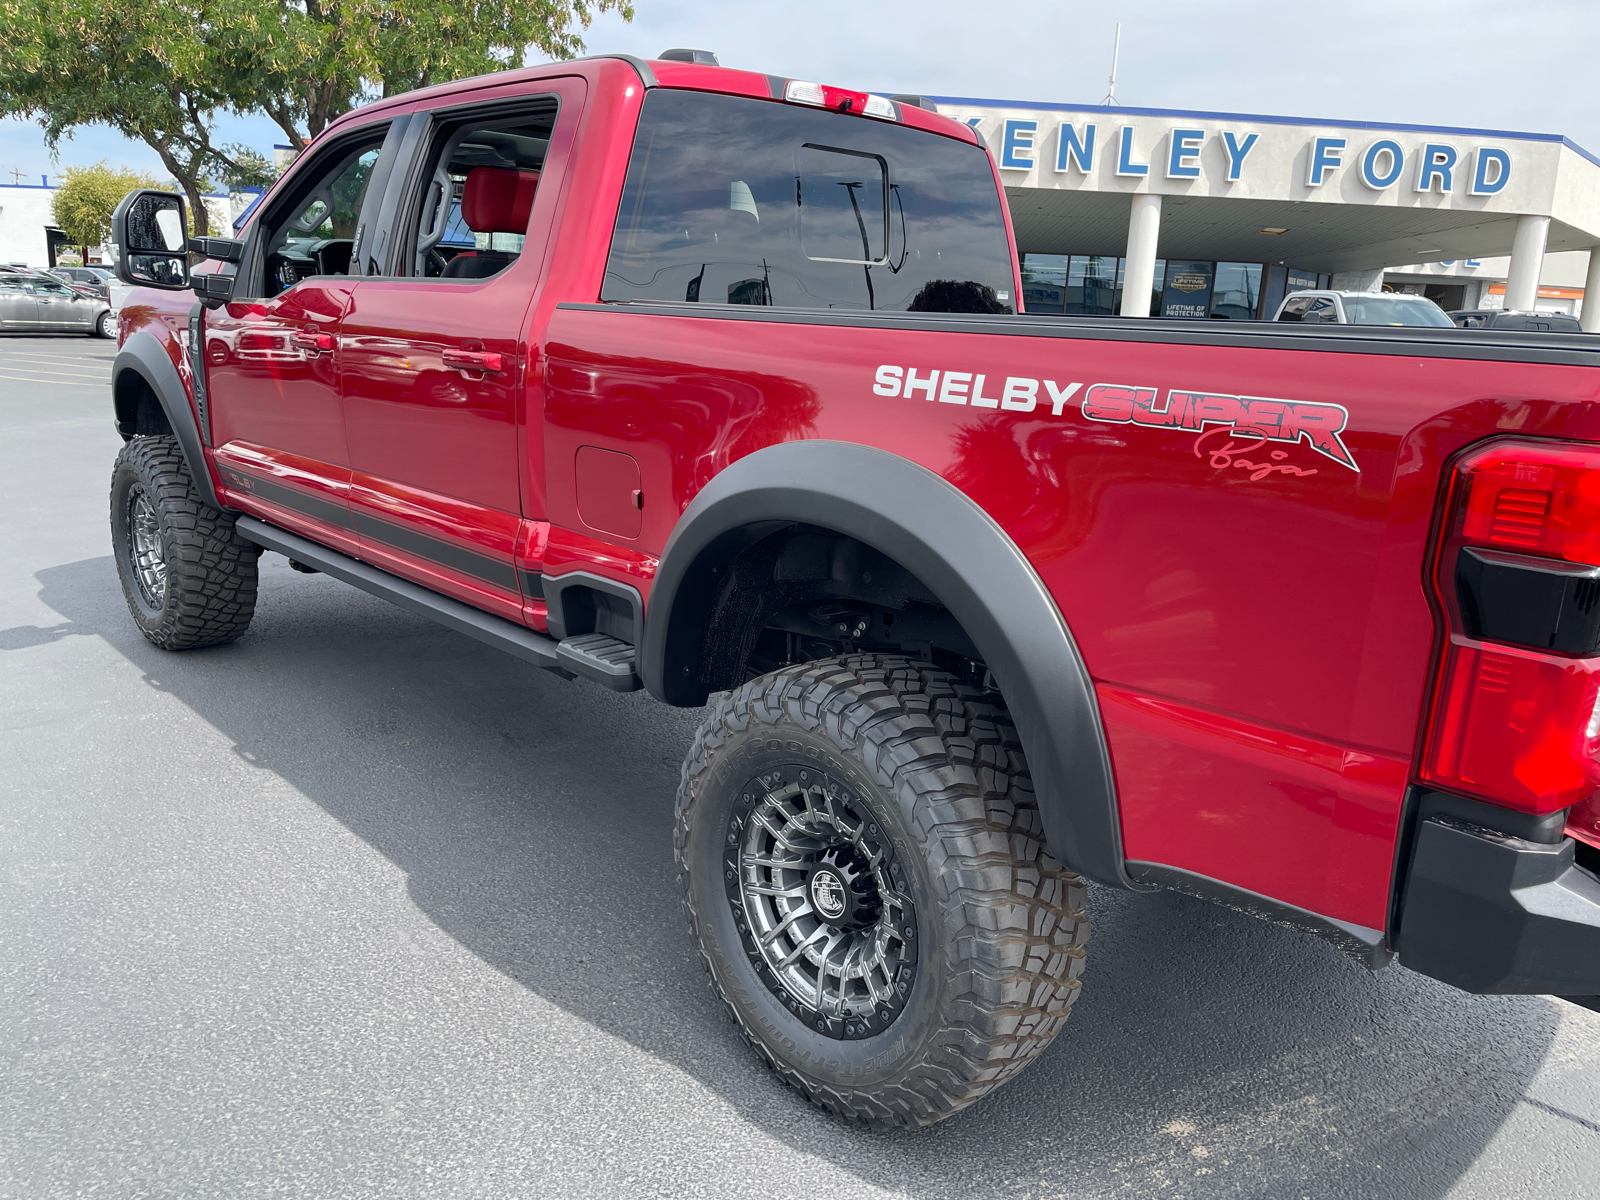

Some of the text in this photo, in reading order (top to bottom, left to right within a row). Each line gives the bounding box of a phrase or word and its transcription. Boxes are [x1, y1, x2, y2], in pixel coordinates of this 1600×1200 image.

[1305, 136, 1513, 196] FORD
[1166, 304, 1195, 312] LIFETIME
[873, 364, 1360, 472] SHELBY SUPER
